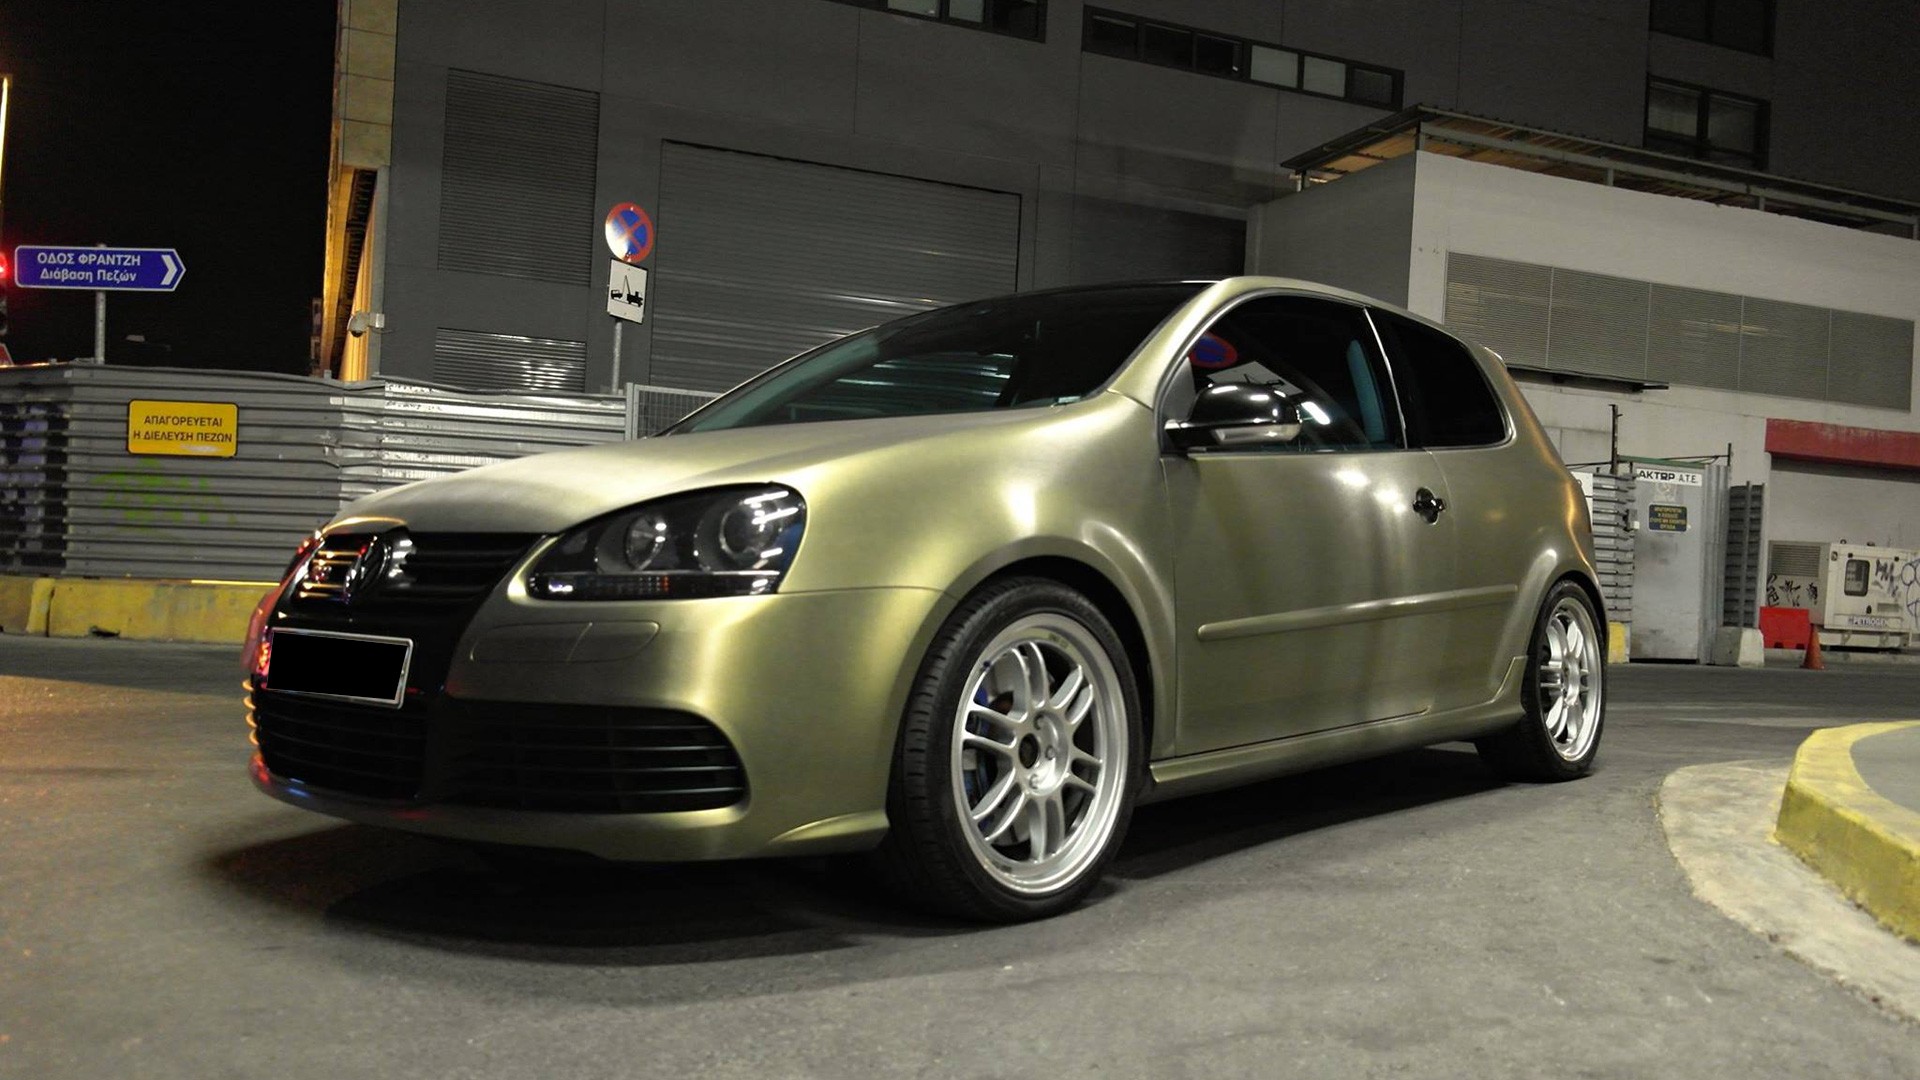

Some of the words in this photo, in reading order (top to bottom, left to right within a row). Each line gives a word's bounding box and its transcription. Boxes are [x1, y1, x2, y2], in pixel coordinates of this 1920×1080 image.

[37, 252, 75, 265] ΟΔΟΣ
[78, 253, 141, 266] ΦΡΑΝΤΖΗ
[40, 268, 93, 283] Διάβαση
[97, 269, 137, 284] Πεζών
[144, 415, 222, 427] ΑΠΑΓΟΡΕΥΕΤΑΙ
[133, 430, 141, 439] Η
[143, 431, 193, 441] ΔΙΕΛΕΥΣΗ
[196, 432, 233, 443] ΠΕΖΩΝ
